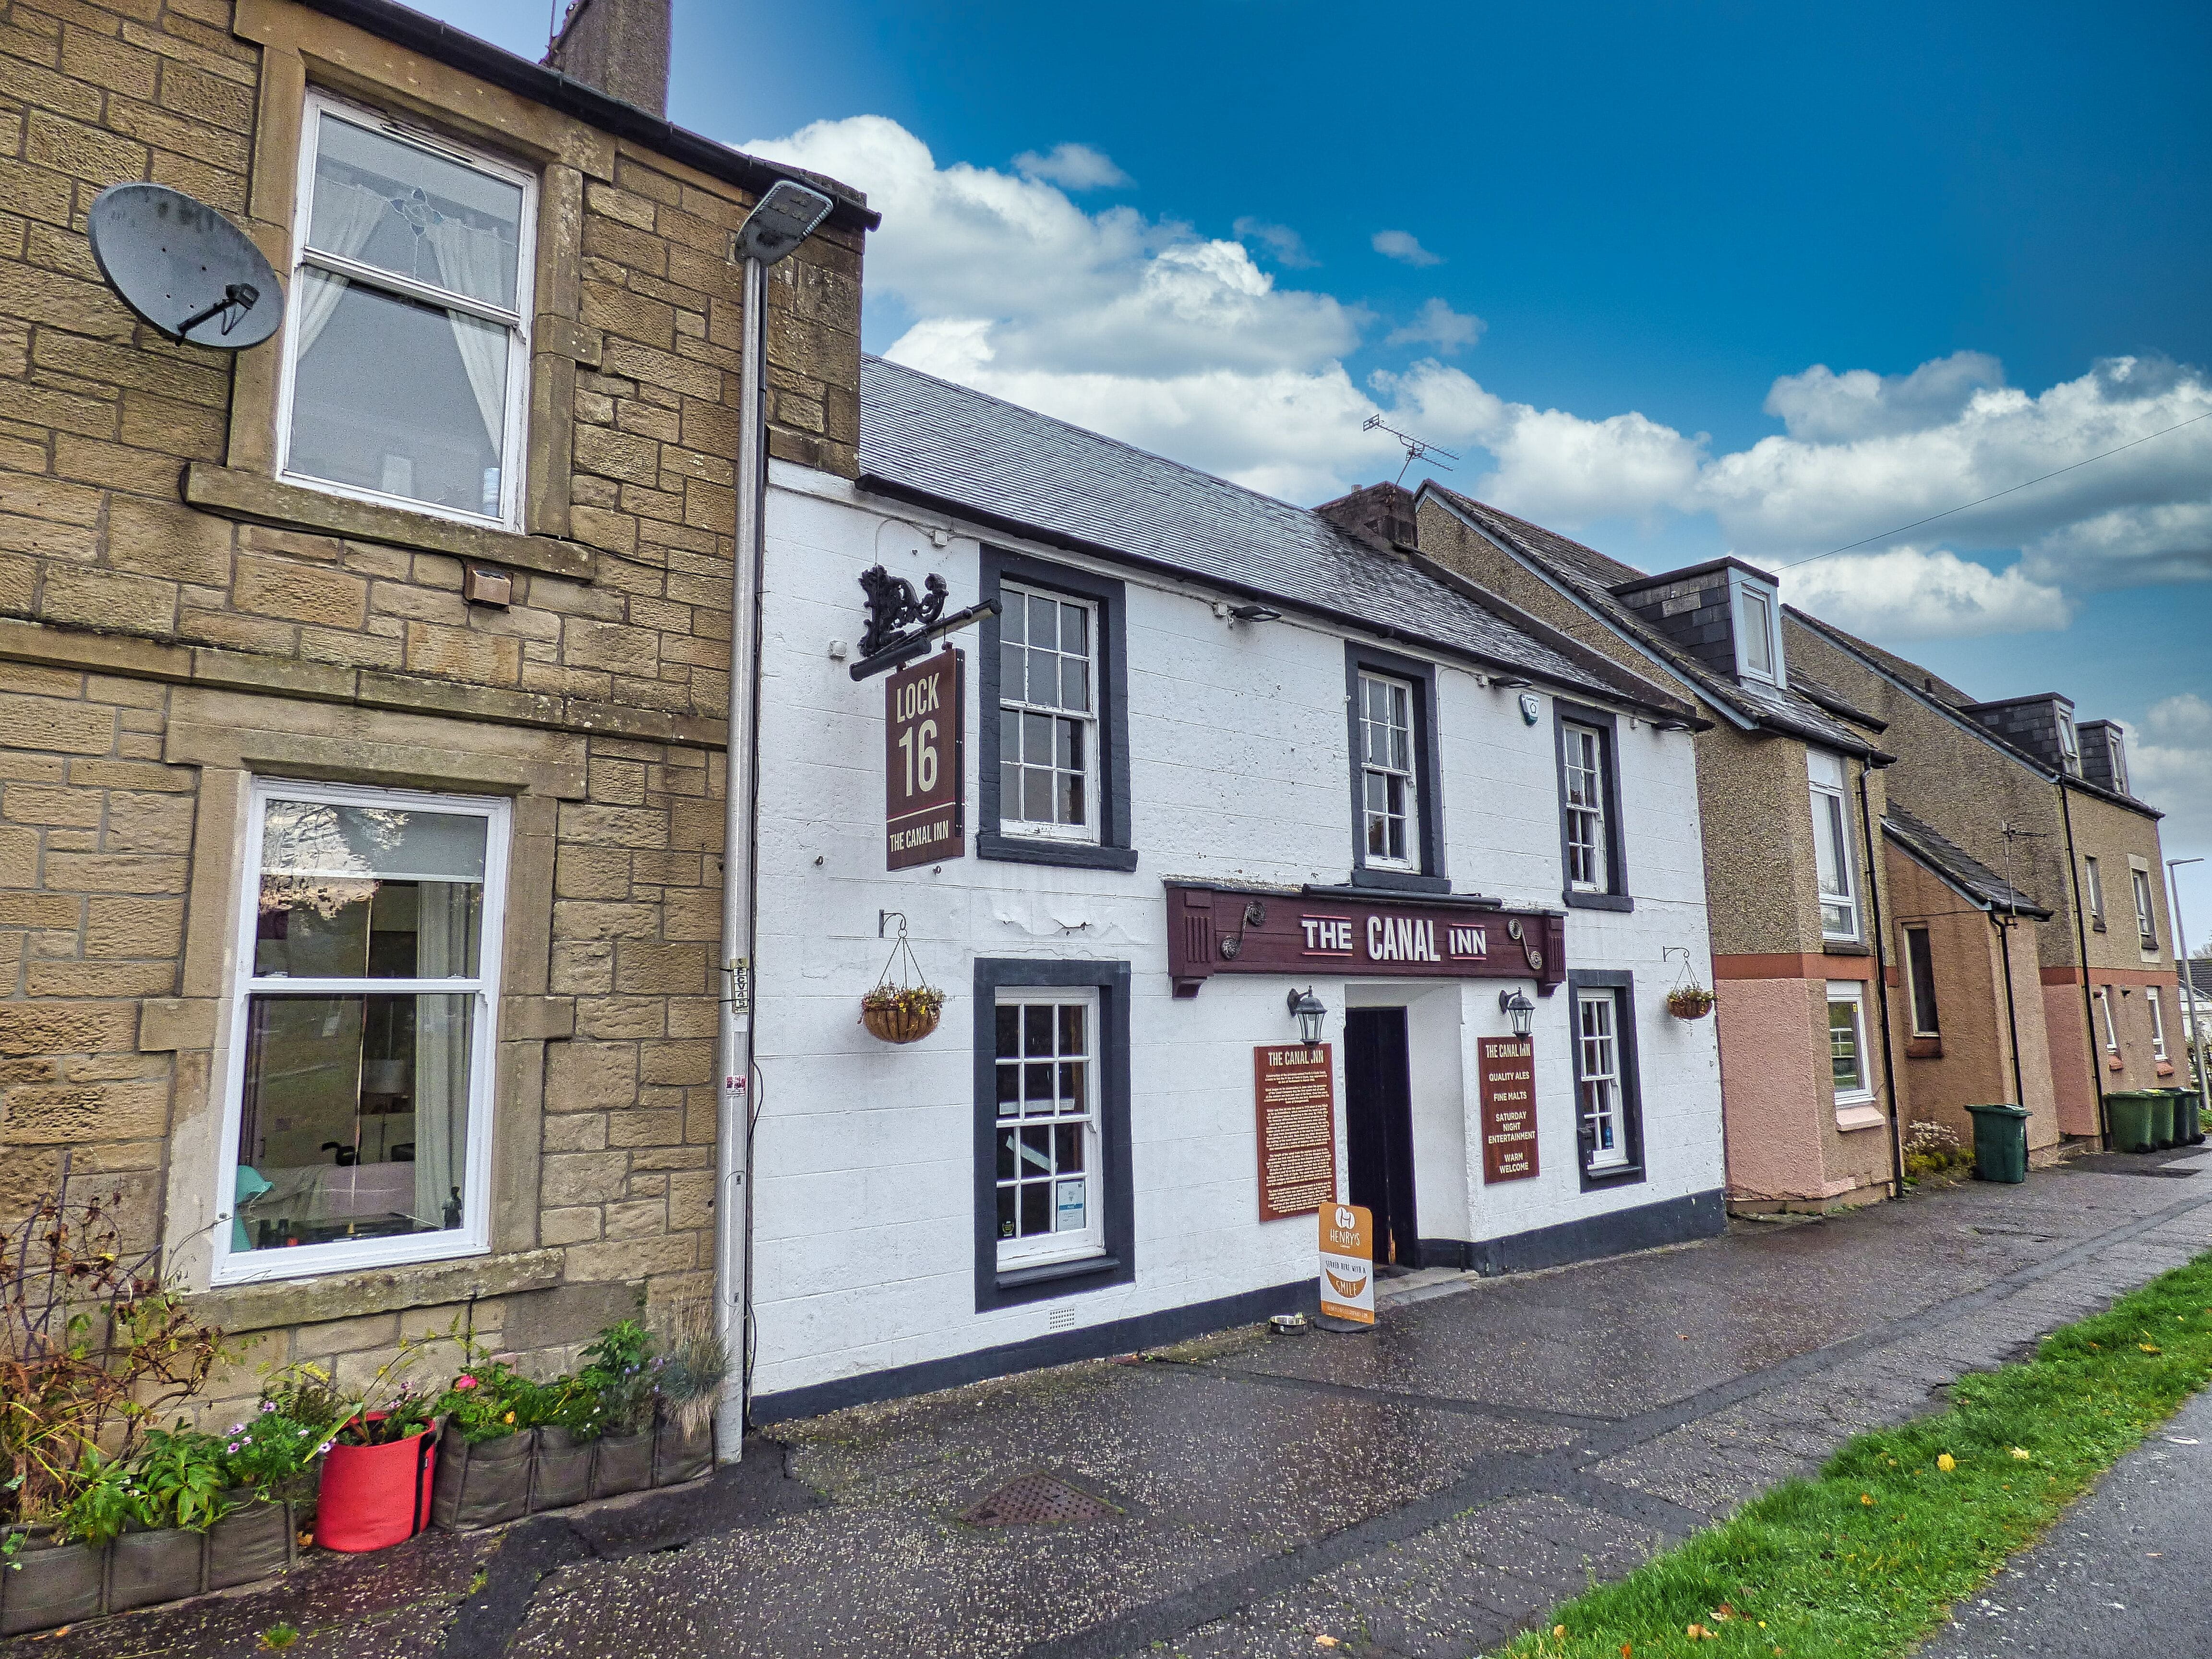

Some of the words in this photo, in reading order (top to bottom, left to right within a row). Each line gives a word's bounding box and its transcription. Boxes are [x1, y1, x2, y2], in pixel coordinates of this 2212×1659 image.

[897, 673, 939, 723] LOCK
[898, 720, 937, 797] 16
[890, 831, 904, 852] THE
[906, 825, 932, 848] CANAL
[934, 819, 949, 841] INN
[1301, 920, 1353, 950] THE
[1367, 915, 1441, 961] CANAL
[1449, 929, 1487, 954] INN
[1268, 1051, 1283, 1066] THE
[1285, 1050, 1310, 1065] CANAL
[1485, 1044, 1498, 1058] THE
[1499, 1044, 1519, 1058] CANAL
[1519, 1043, 1531, 1057] INN
[1489, 1072, 1514, 1082] QUALITY
[1515, 1071, 1530, 1080] ALES
[1493, 1092, 1507, 1102] FINE
[1508, 1091, 1527, 1101] MALTS
[1495, 1111, 1527, 1122] SATURDAY
[1503, 1122, 1521, 1131] NIGHT
[1488, 1130, 1536, 1144] ENTERTAINMENT
[1504, 1152, 1523, 1162] WARM
[1499, 1162, 1529, 1174] WELCOME
[1330, 1228, 1360, 1246] HENRY'S
[1336, 1280, 1357, 1297] SMILE
